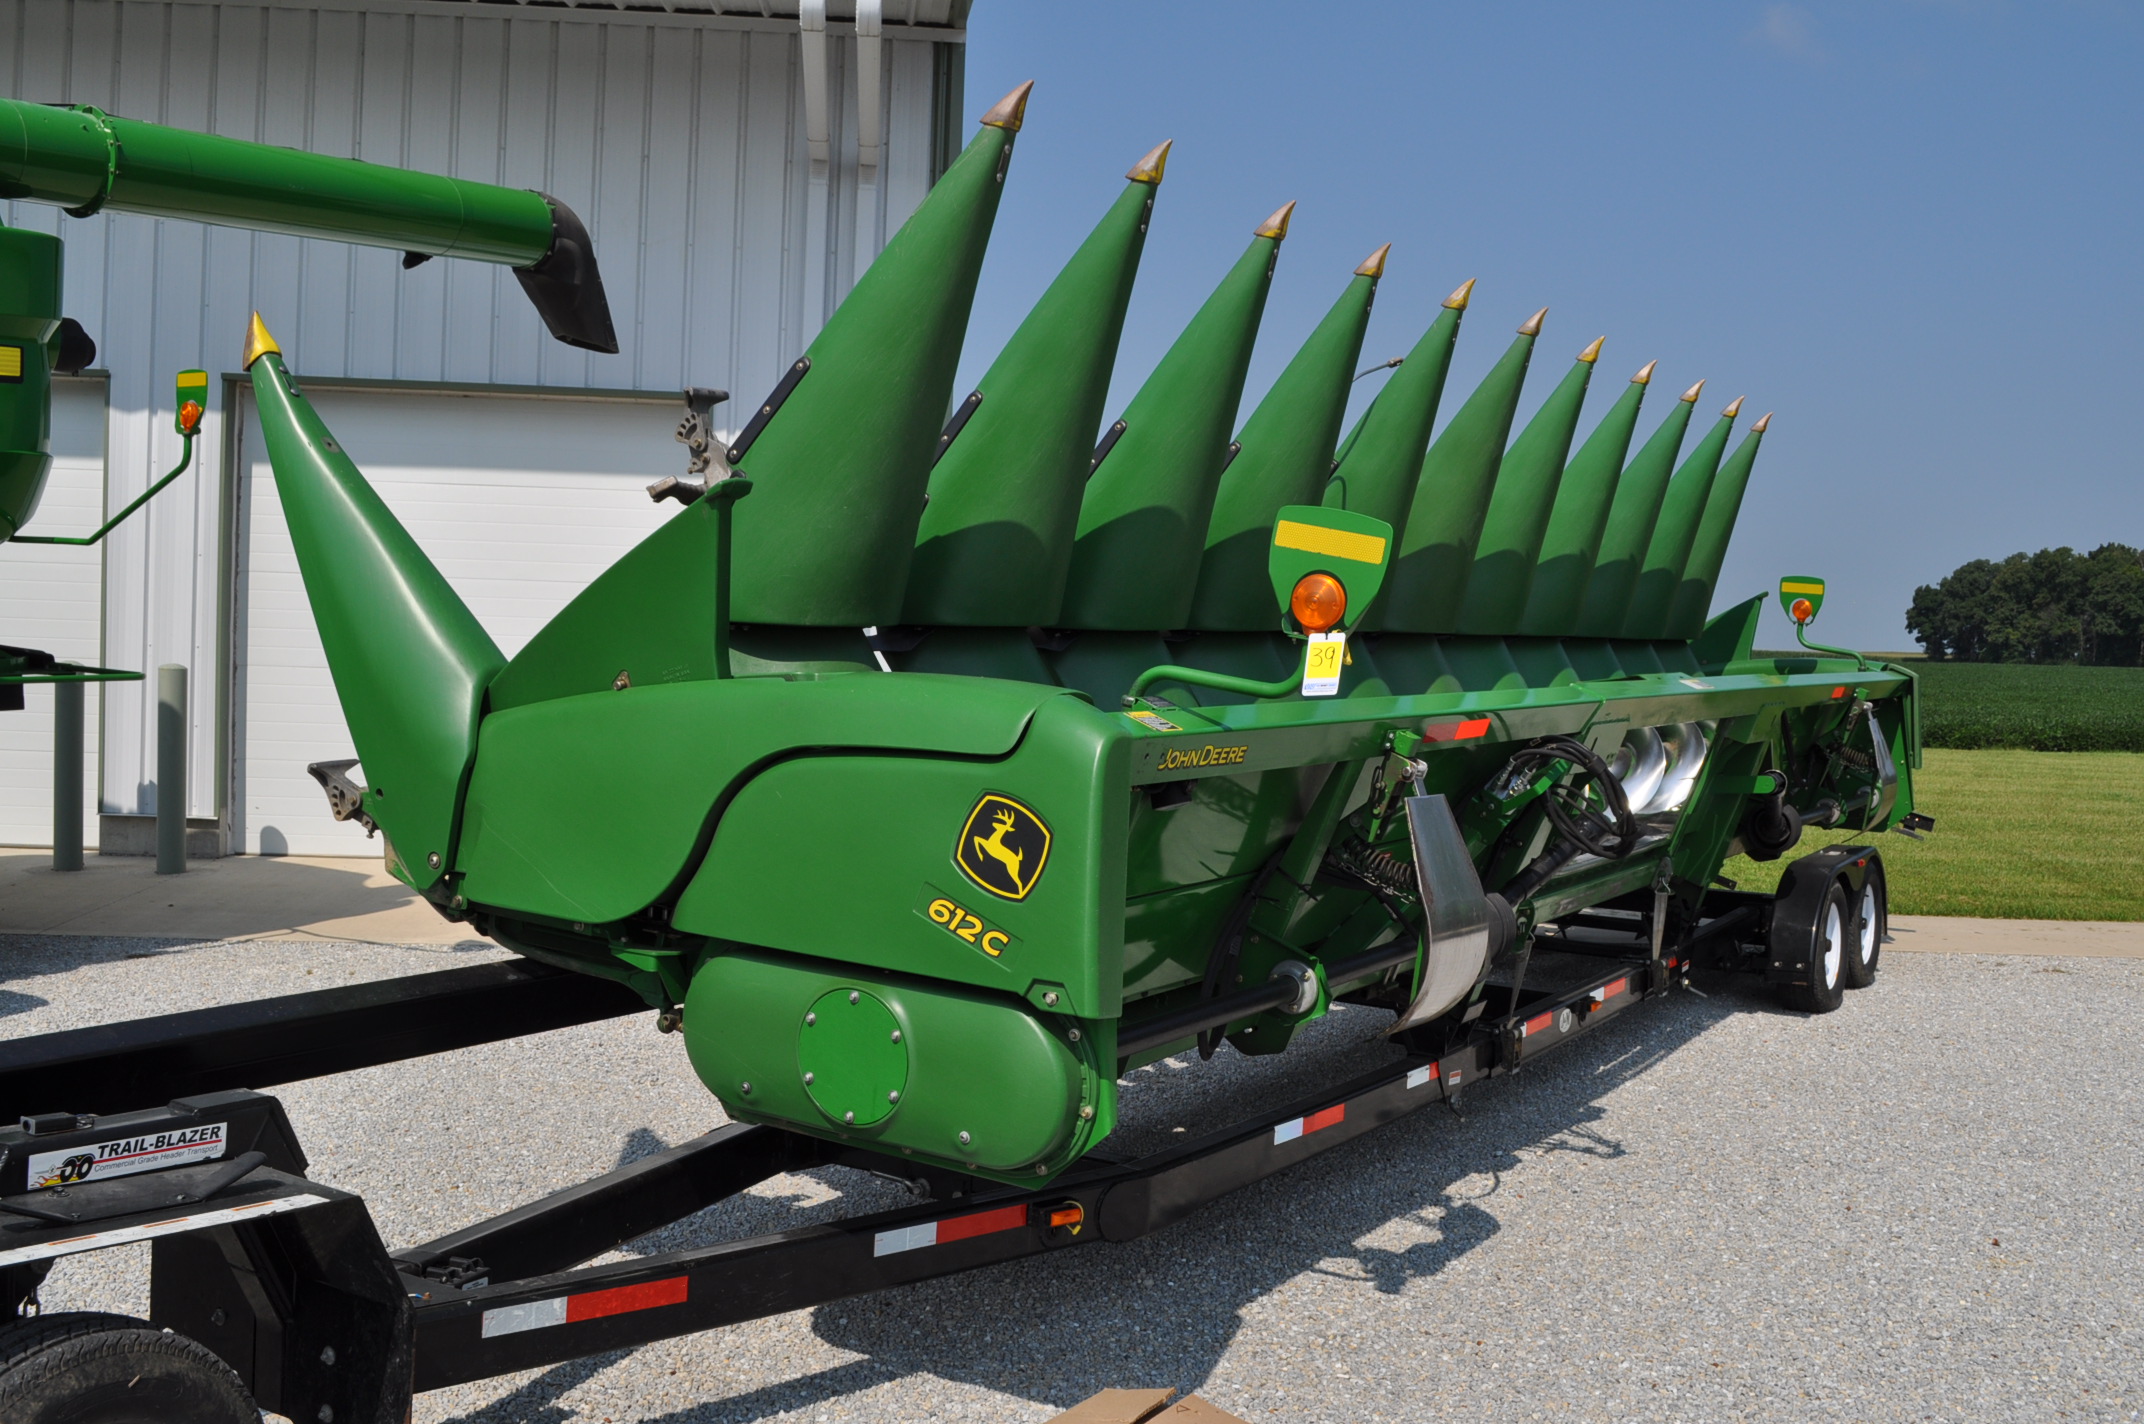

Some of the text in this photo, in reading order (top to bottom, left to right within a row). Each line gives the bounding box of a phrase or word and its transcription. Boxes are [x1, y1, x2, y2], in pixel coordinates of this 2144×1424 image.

[1310, 646, 1336, 669] 39
[1157, 745, 1248, 771] JOHN DEERE
[98, 1126, 222, 1159] TRAIL-BLAZER
[94, 1144, 219, 1173] Commercial Grade Header Transport
